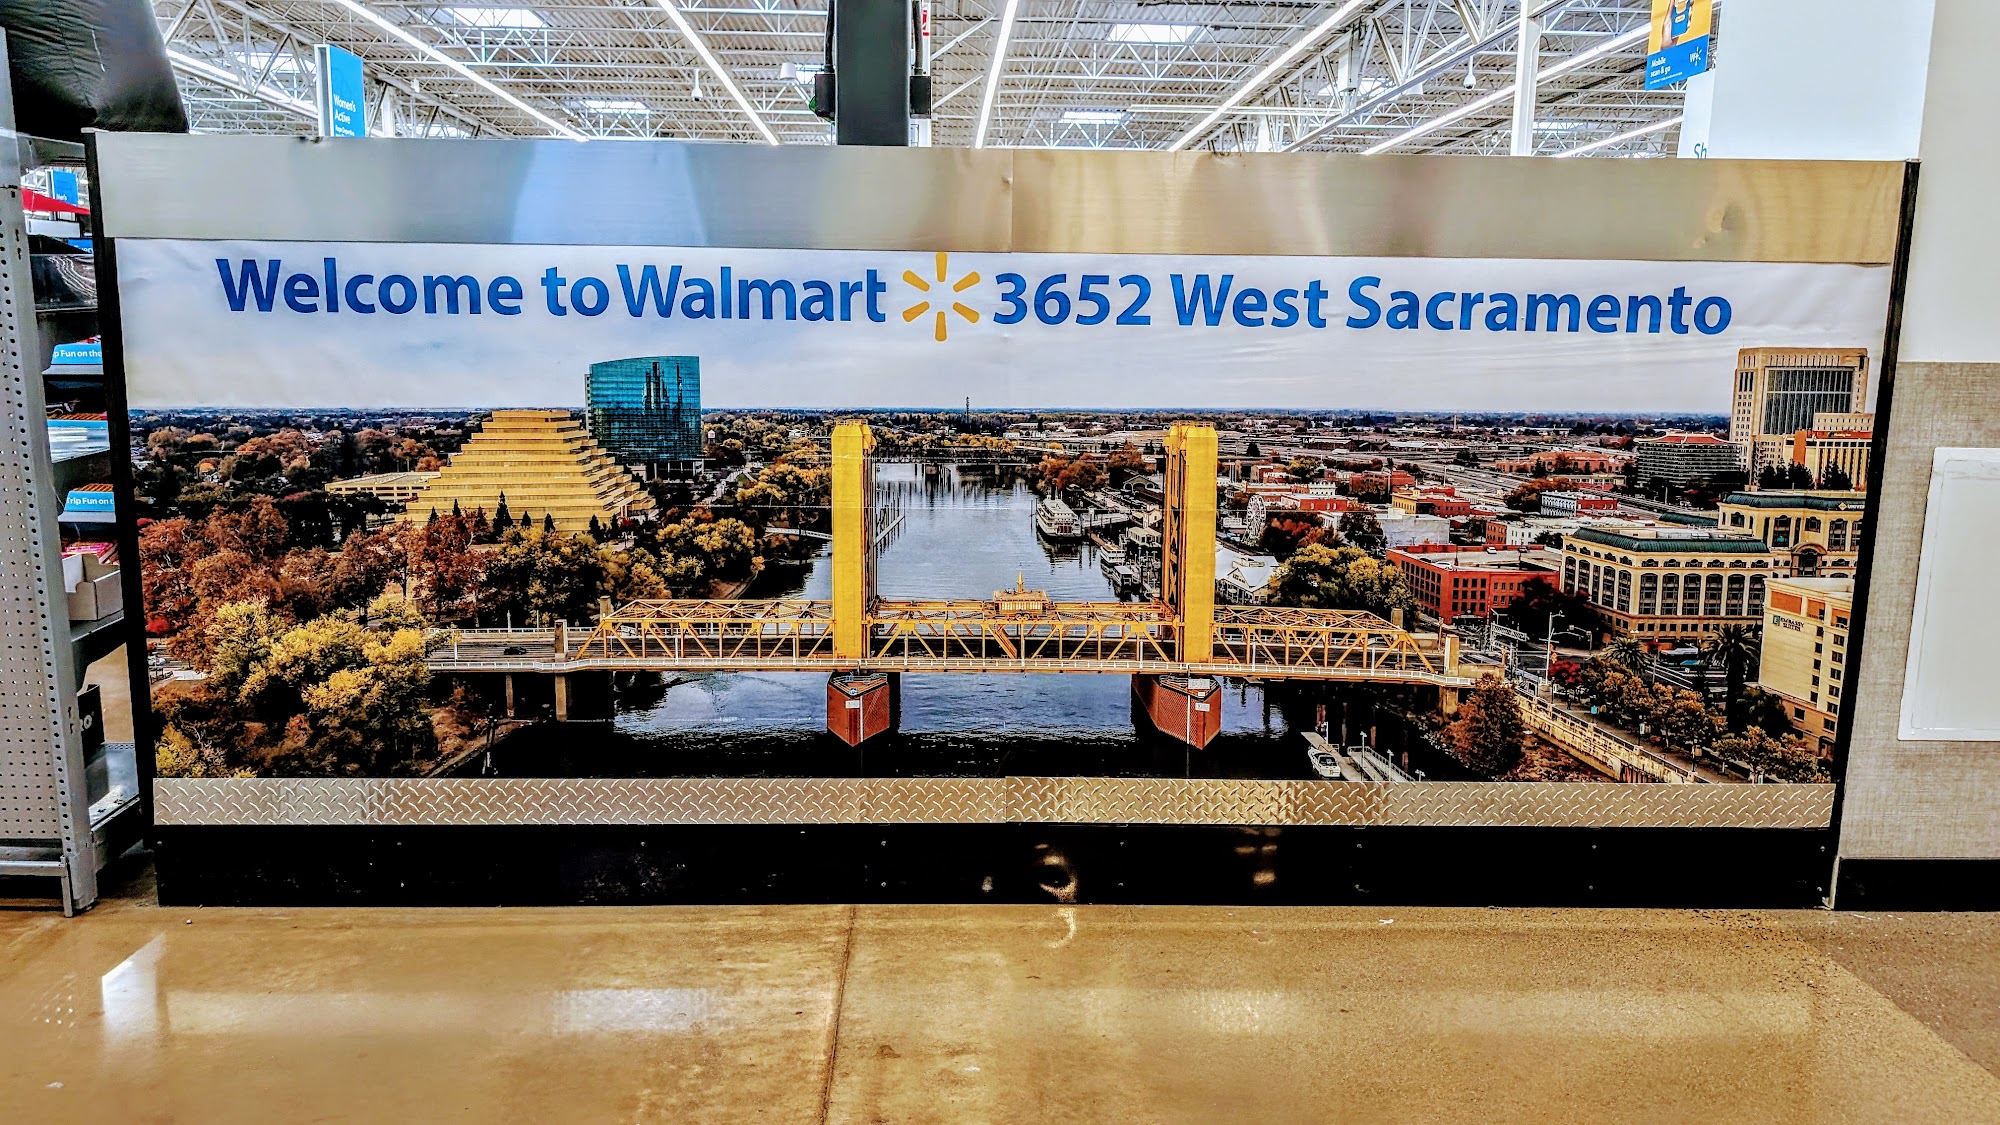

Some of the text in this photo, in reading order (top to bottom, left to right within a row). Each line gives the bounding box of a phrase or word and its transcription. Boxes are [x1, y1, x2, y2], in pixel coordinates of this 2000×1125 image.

[1651, 56, 1666, 67] Mobile
[1650, 69, 1660, 77] scan
[334, 94, 356, 112] Women's
[335, 109, 351, 124] Active
[215, 257, 1733, 336] Welcome to Walmart 3652 West Sacramento
[60, 349, 76, 357] Fun
[82, 497, 98, 505] Fun
[1780, 617, 1804, 627] EMBASSY
[1783, 622, 1801, 632] SUITES
